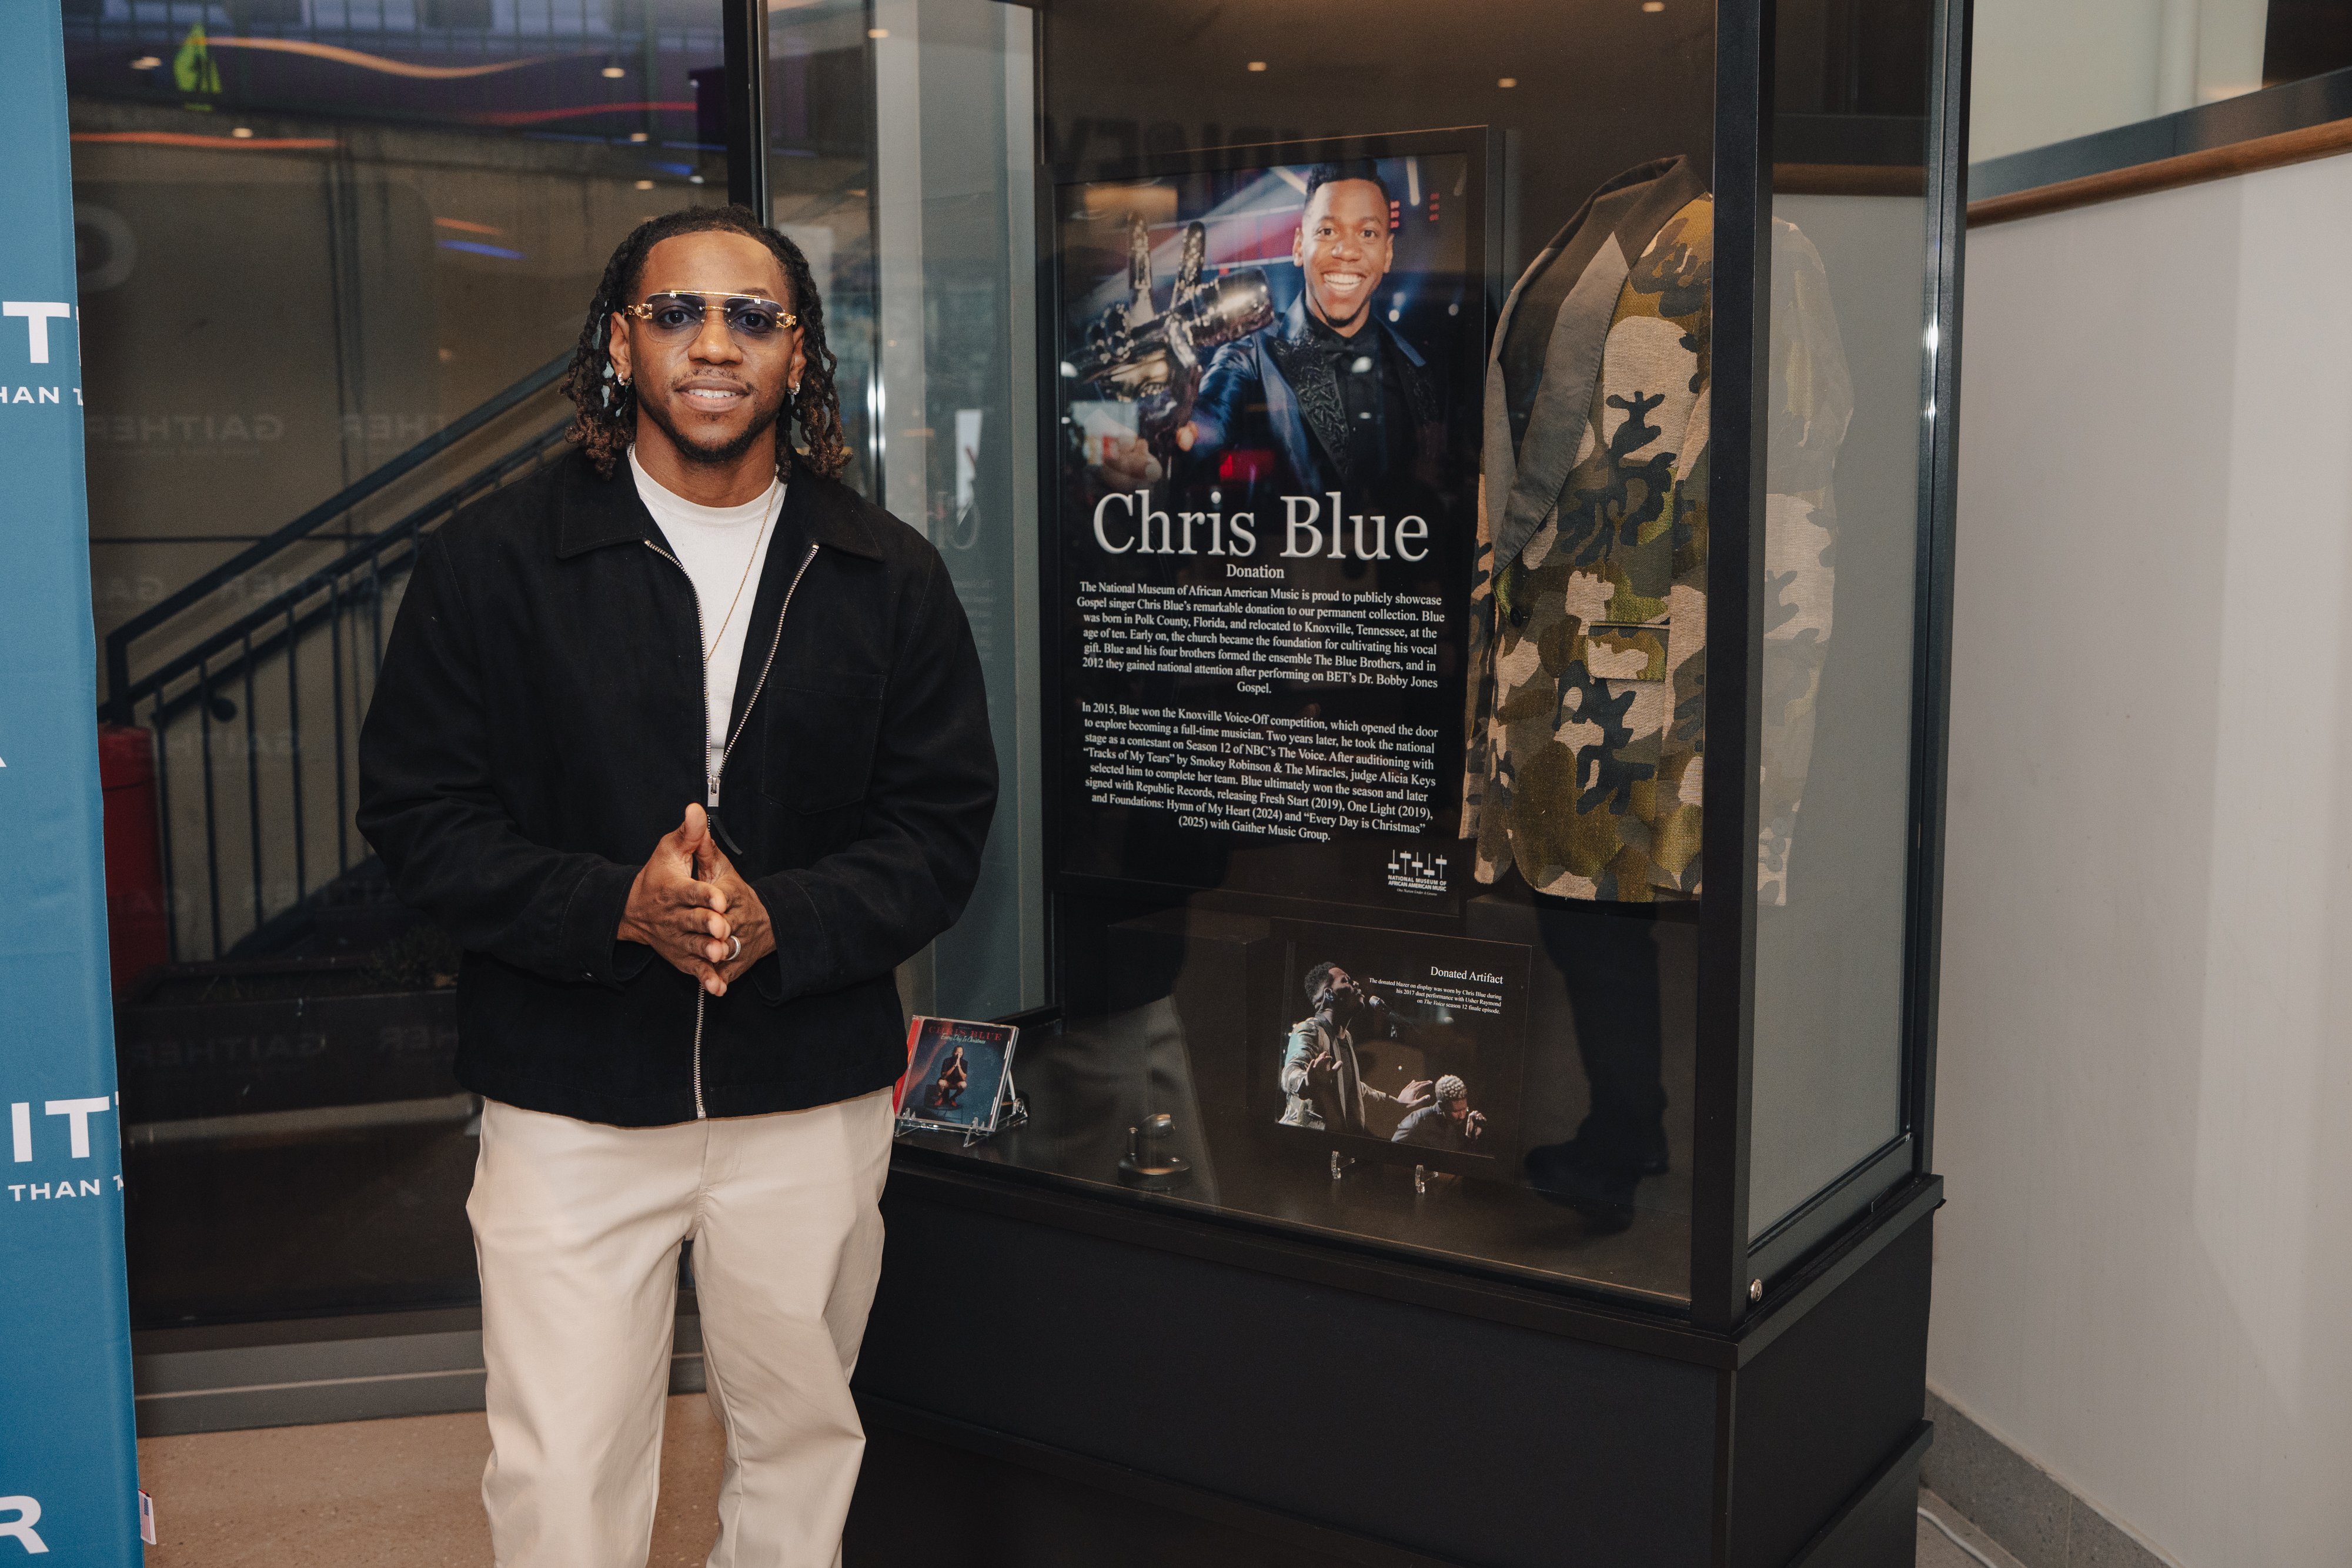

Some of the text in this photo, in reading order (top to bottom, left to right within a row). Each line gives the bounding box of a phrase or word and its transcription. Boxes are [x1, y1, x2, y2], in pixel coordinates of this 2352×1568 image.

[2, 302, 81, 366] T
[1094, 489, 1429, 561] Chris Blue
[1227, 564, 1284, 579] Donation
[1080, 581, 1442, 606] The National Museum of African American Music is proud to publicly showcase
[1077, 597, 1107, 609] Gospel
[1109, 598, 1135, 611] singer
[1137, 599, 1161, 609] Chris
[1194, 602, 1243, 613] remarkable
[1245, 603, 1284, 615] donation
[1288, 607, 1297, 615] to
[1317, 609, 1366, 619] permanent
[1369, 609, 1418, 621] collection.
[1422, 611, 1445, 622] Blue
[1102, 613, 1121, 623] born
[1124, 614, 1132, 623] in
[1135, 614, 1154, 624] Polk
[1157, 615, 1191, 628] County,
[1194, 617, 1228, 629] Florida,
[1230, 618, 1247, 629] and
[1249, 620, 1290, 631] relocated
[1293, 623, 1302, 631] to
[1305, 621, 1354, 635] Knoxville,
[1356, 624, 1408, 638] Tennessee,
[1411, 628, 1419, 637] at
[1422, 627, 1437, 638] the
[1083, 628, 1436, 655] age of ten. Early on, the church became the foundation for cultivating his vocal
[1084, 642, 1436, 671] gift. Blue and his four brothers formed the ensemble The Blue Brothers, and in
[1083, 657, 1103, 668] 2012
[1106, 658, 1124, 671] they
[1127, 660, 1155, 672] gained
[1157, 662, 1192, 673] national
[1195, 664, 1232, 675] attention
[1235, 666, 1256, 676] after
[1258, 668, 1309, 683] performing
[1359, 673, 1373, 684] Dr.
[1377, 674, 1408, 688] Bobby
[1411, 676, 1438, 688] Jones
[1237, 681, 1271, 695] Gospel.
[1083, 702, 1091, 712] In
[1093, 703, 1117, 715] 2015,
[1120, 704, 1140, 715] Blue
[1162, 708, 1176, 718] the
[1178, 708, 1222, 721] Knoxville
[1224, 711, 1269, 724] Voice-Off
[1270, 716, 1328, 730] competition,
[1330, 720, 1358, 731] which
[1361, 724, 1395, 735] opened
[1398, 724, 1413, 735] the
[1416, 726, 1438, 737] door
[1178, 816, 1330, 842] (2025) with Gaither Music Group.
[1431, 967, 1503, 984] Donated Artifact
[971, 1030, 1002, 1041] BLUE
[11, 1091, 121, 1162] IT
[8, 1179, 100, 1202] THAN
